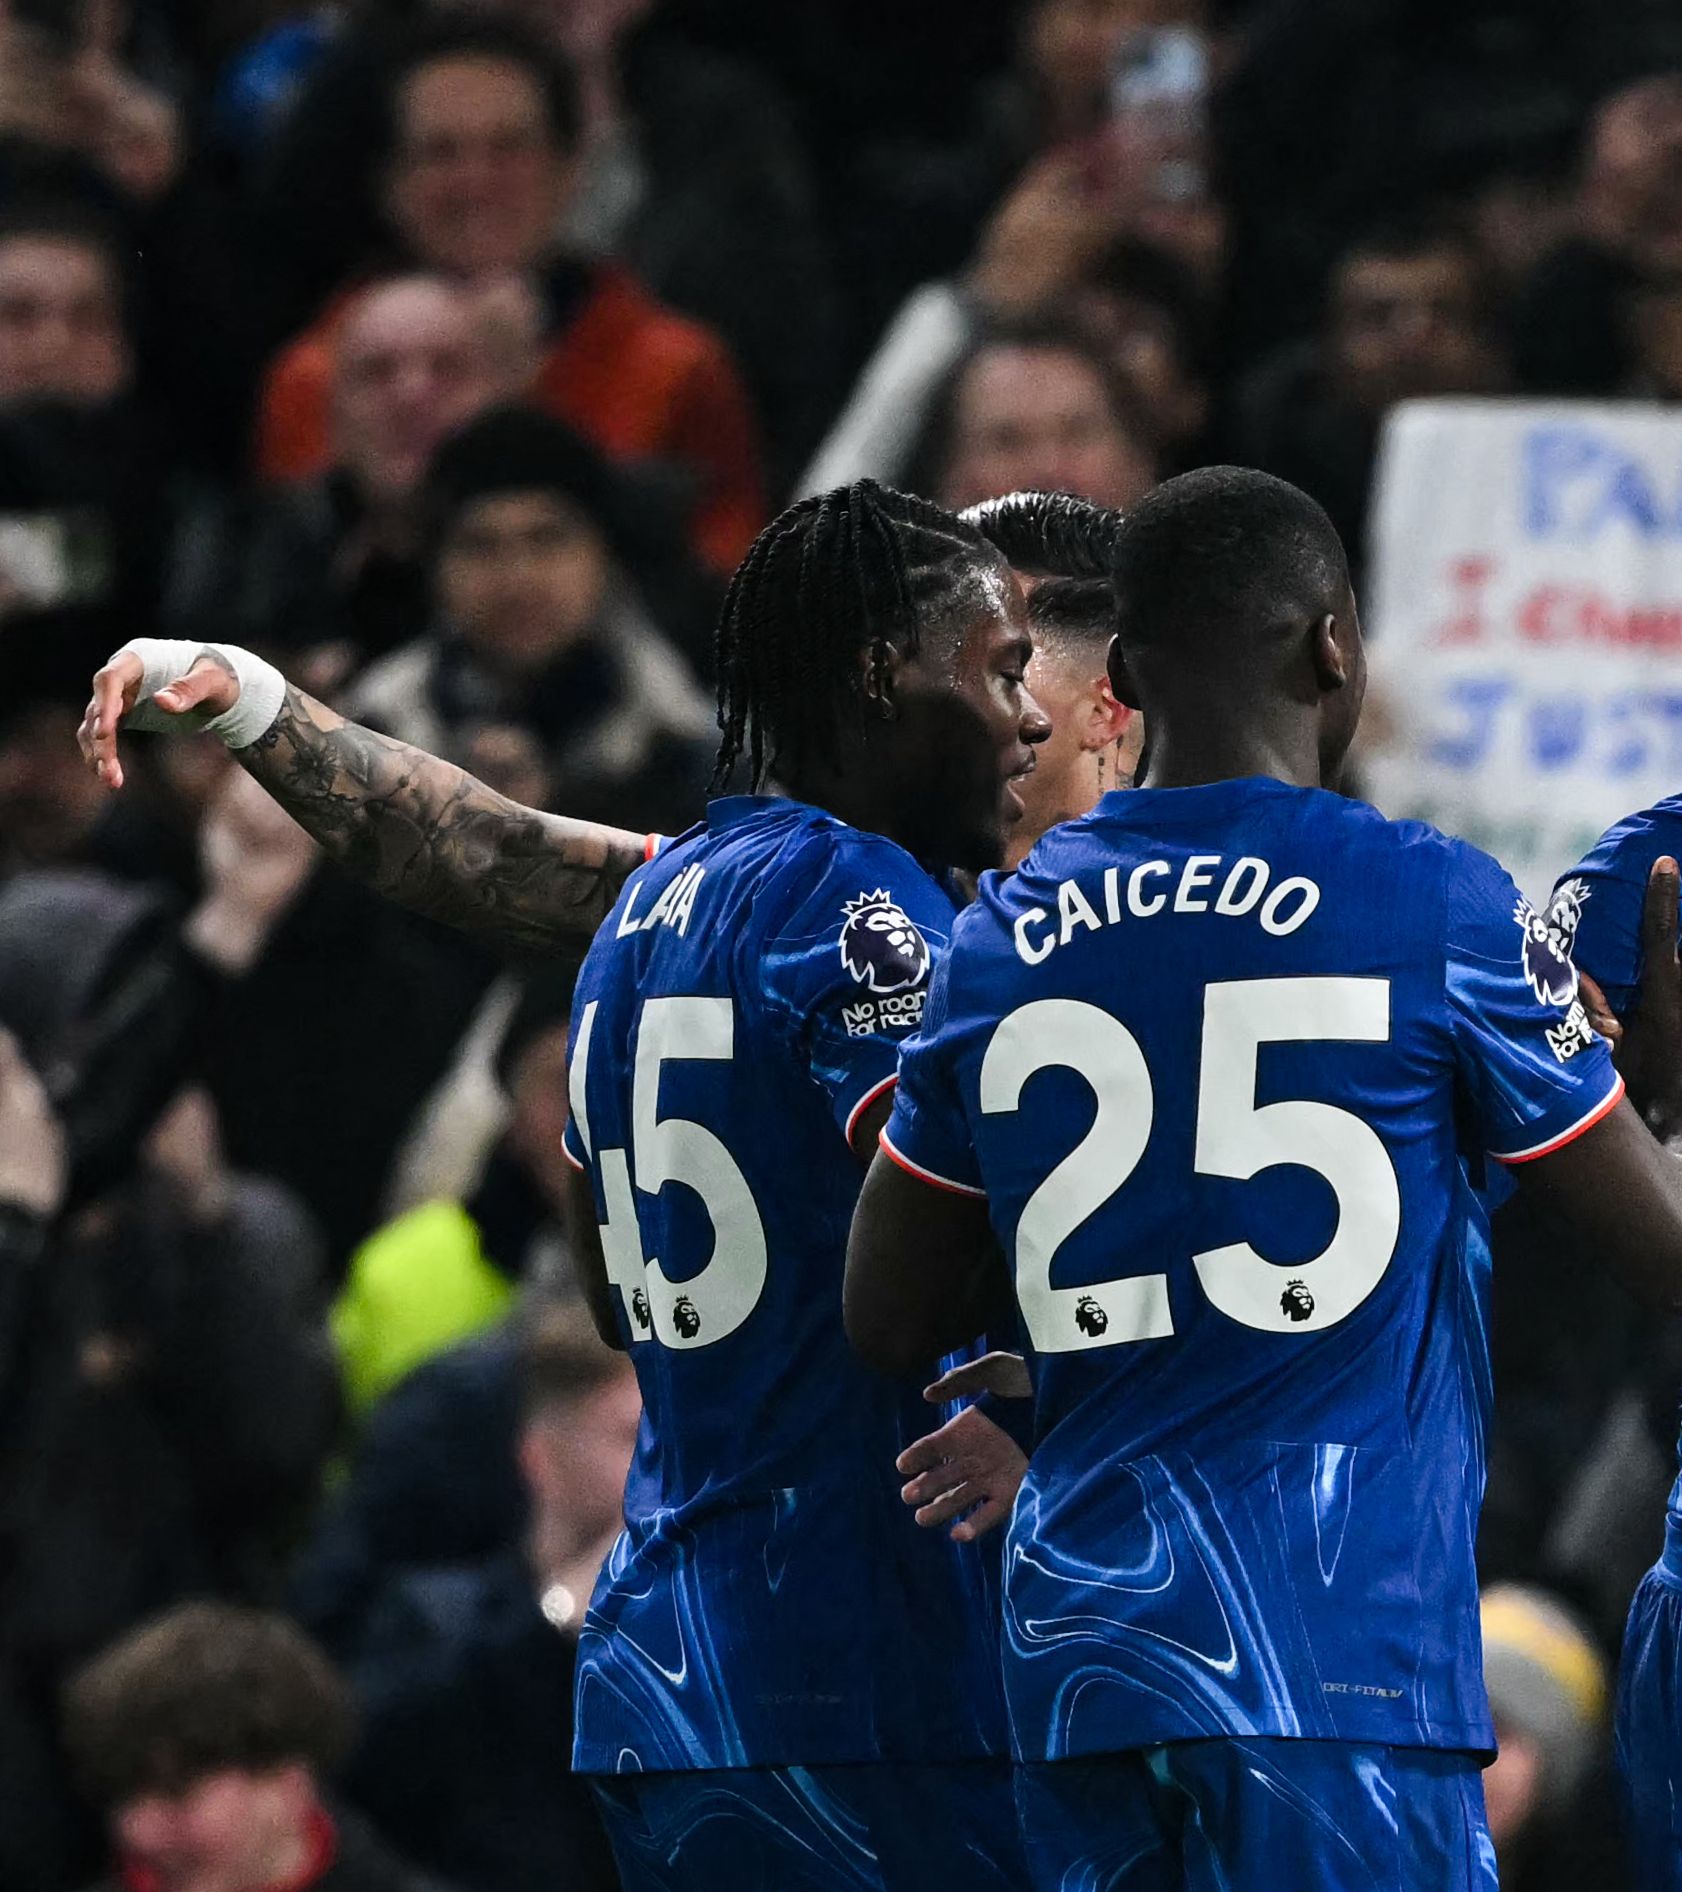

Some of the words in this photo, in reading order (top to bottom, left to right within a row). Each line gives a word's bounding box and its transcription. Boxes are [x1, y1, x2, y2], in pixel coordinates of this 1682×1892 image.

[616, 862, 706, 940] LAIA
[1013, 855, 1321, 965] CAICEDO
[841, 1002, 875, 1024] No
[847, 1018, 877, 1038] for
[980, 976, 1400, 1353] 25
